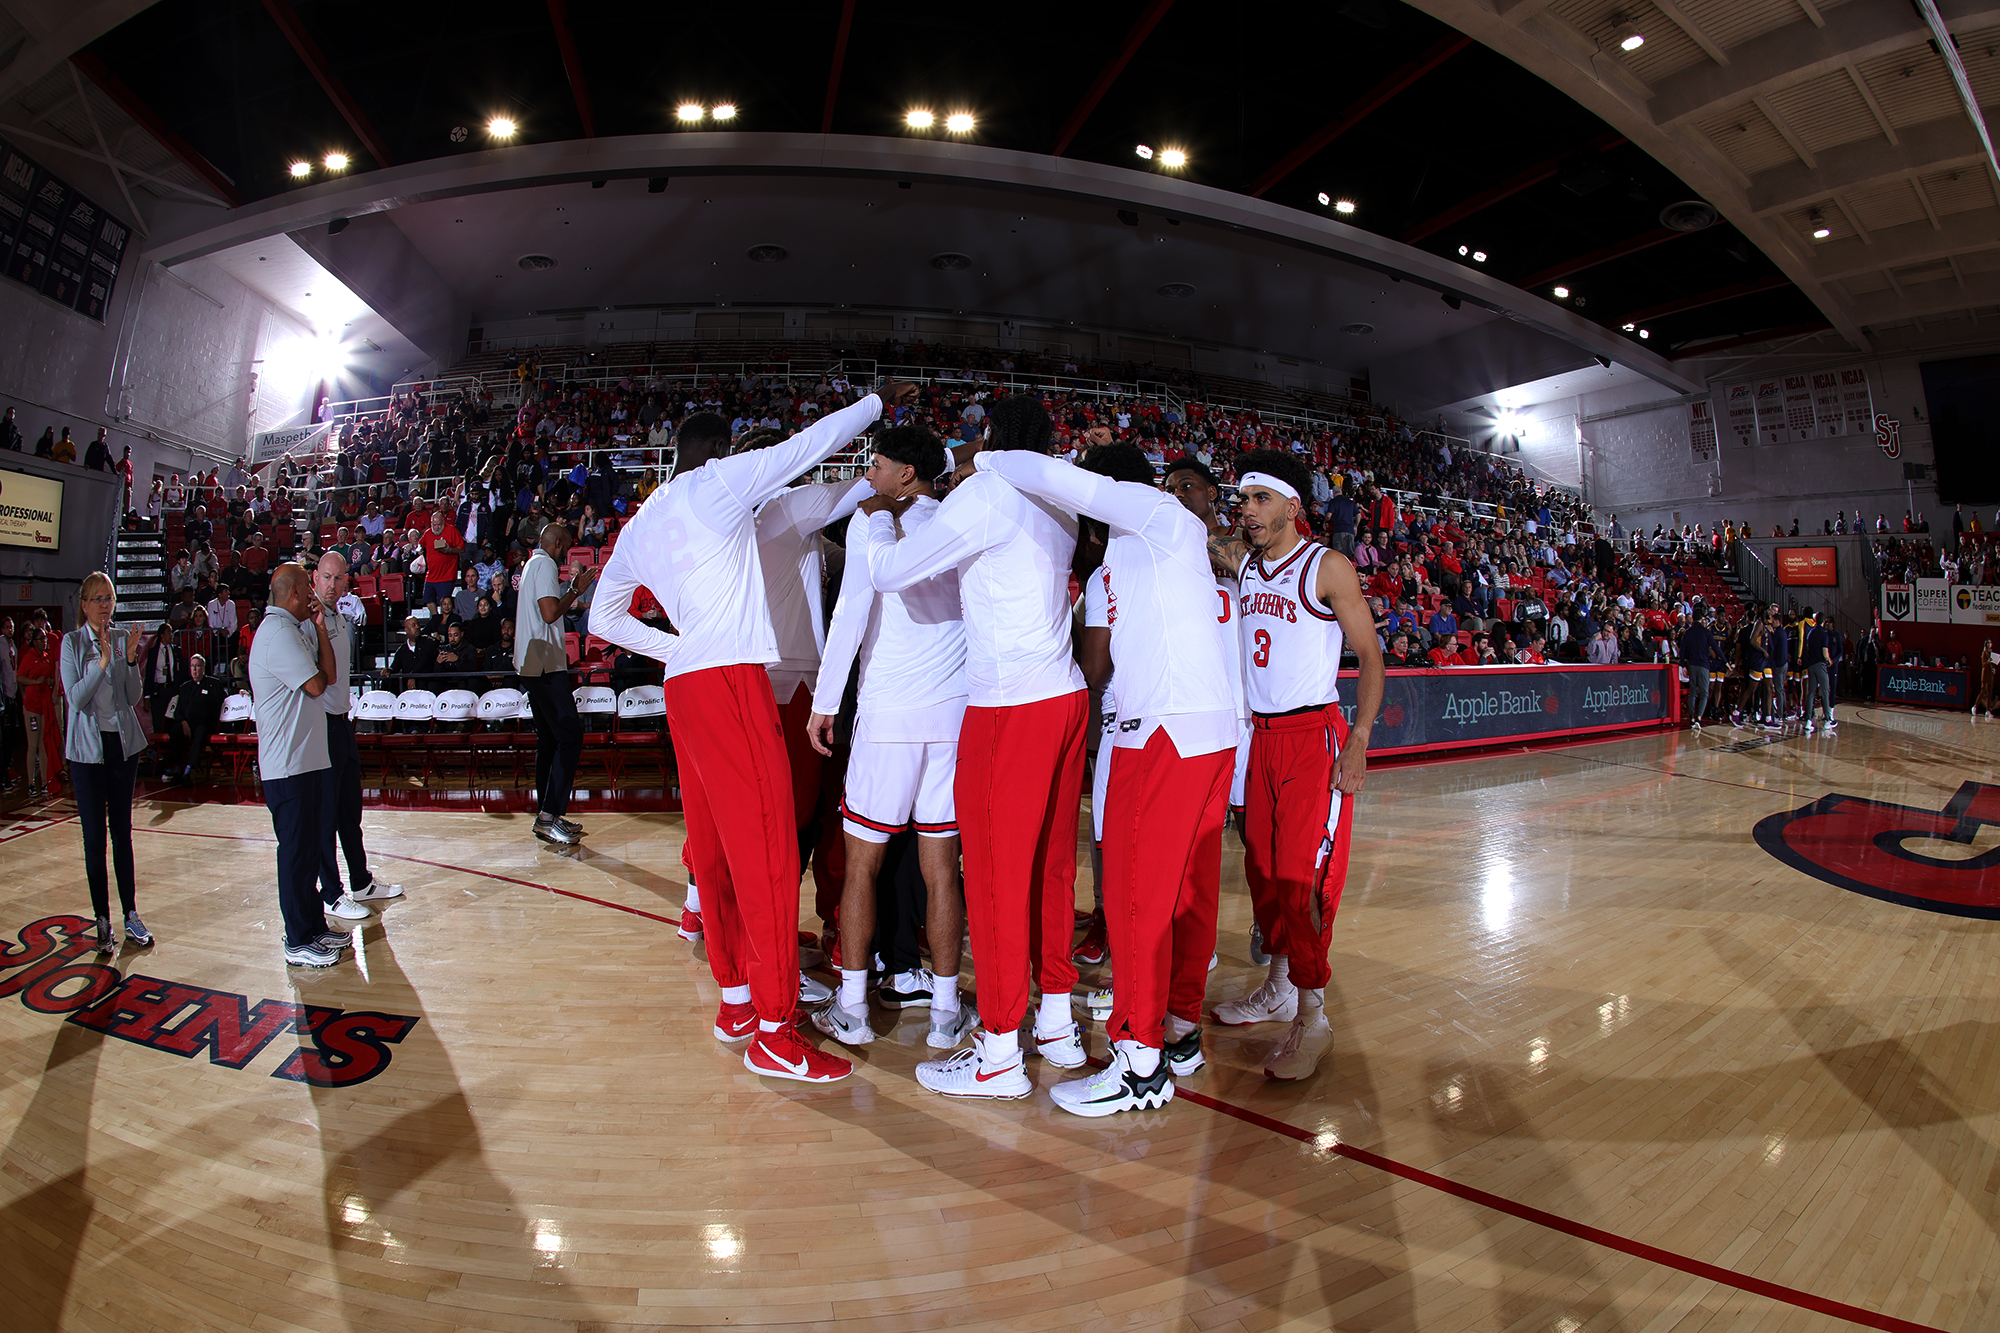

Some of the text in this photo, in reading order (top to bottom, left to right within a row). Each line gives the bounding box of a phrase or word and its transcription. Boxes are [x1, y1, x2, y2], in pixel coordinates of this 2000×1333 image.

[3, 152, 35, 192] NCAA
[45, 180, 64, 194] BIG
[40, 188, 65, 205] EAST
[78, 202, 94, 216] BIG
[72, 208, 96, 225] EAST
[100, 218, 126, 250] NIVC
[1785, 376, 1806, 390] NCAA
[1812, 373, 1837, 389] NCAA
[1841, 369, 1865, 386] NCAA
[1758, 388, 1780, 396] EAST
[1760, 382, 1774, 390] BIG
[1731, 390, 1750, 398] EAST
[1818, 396, 1832, 405] SWEET
[1692, 402, 1706, 418] NIT
[1730, 408, 1754, 417] CHAMPIONS
[1758, 406, 1783, 416] CHAMPIONS
[262, 428, 311, 446] Maspeth
[21, 585, 32, 598] EXIT
[1918, 590, 1947, 598] SUPER
[1251, 593, 1297, 624] JOHN'S
[1918, 598, 1948, 606] COFFEE
[1254, 629, 1272, 668] 3
